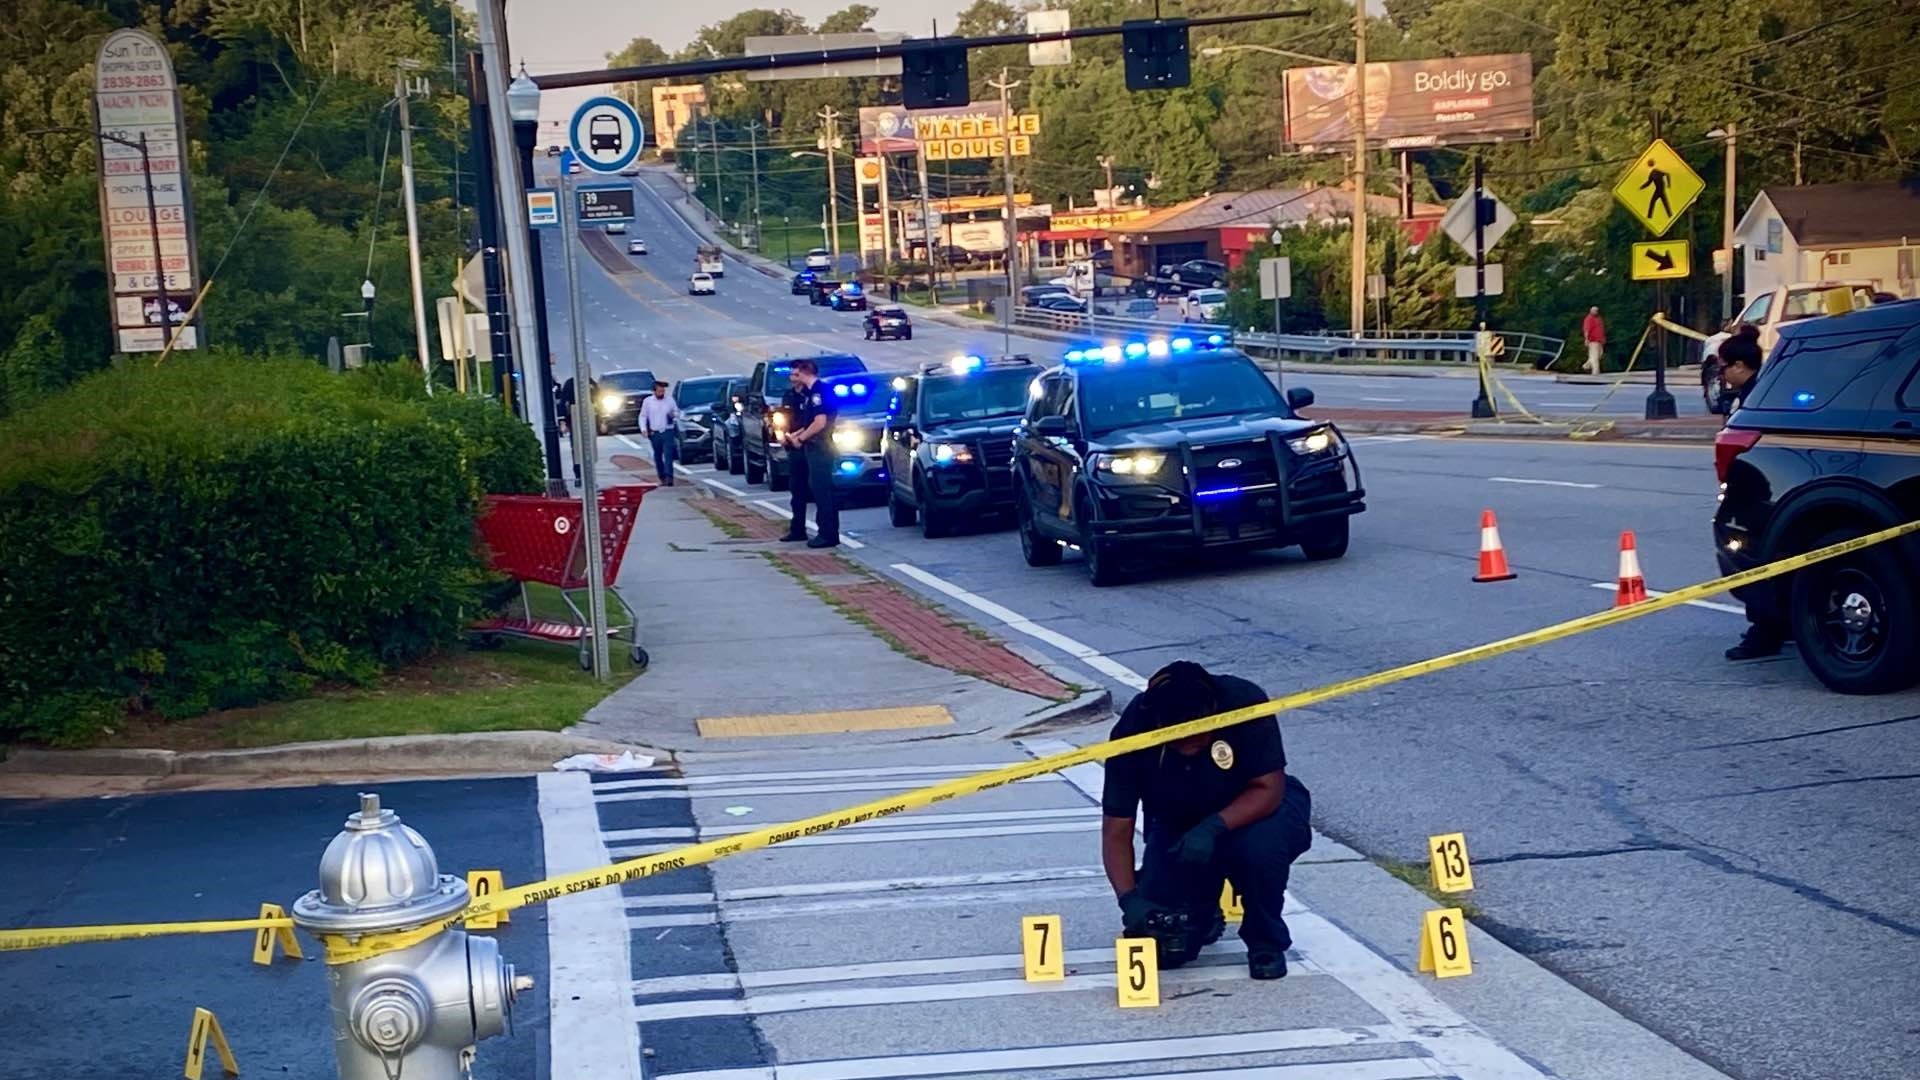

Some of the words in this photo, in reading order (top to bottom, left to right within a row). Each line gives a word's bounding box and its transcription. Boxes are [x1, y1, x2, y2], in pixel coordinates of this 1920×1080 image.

[104, 48, 129, 58] Sun
[132, 43, 157, 57] Tan
[103, 75, 164, 88] 2839-2863
[1415, 69, 1477, 93] Boldly
[1480, 71, 1511, 92] go.
[918, 118, 1035, 138] WAFFE
[931, 139, 1026, 155] HOUSE
[134, 159, 177, 173] LANDRY
[585, 193, 597, 204] 39
[113, 208, 180, 222] LOUGE
[768, 830, 800, 845] CRIME
[805, 821, 834, 836] SCENE
[837, 817, 850, 828] DO
[854, 812, 873, 823] NOT
[876, 805, 906, 818] CROSS
[1436, 840, 1465, 879] 13
[524, 887, 561, 905] CRIME
[566, 877, 600, 893] SCENE
[606, 873, 621, 885] DO
[625, 866, 646, 880] NOT
[651, 857, 685, 874] CROSS
[1033, 923, 1049, 966] 7
[1439, 916, 1457, 961] 6
[1129, 946, 1146, 991] 5
